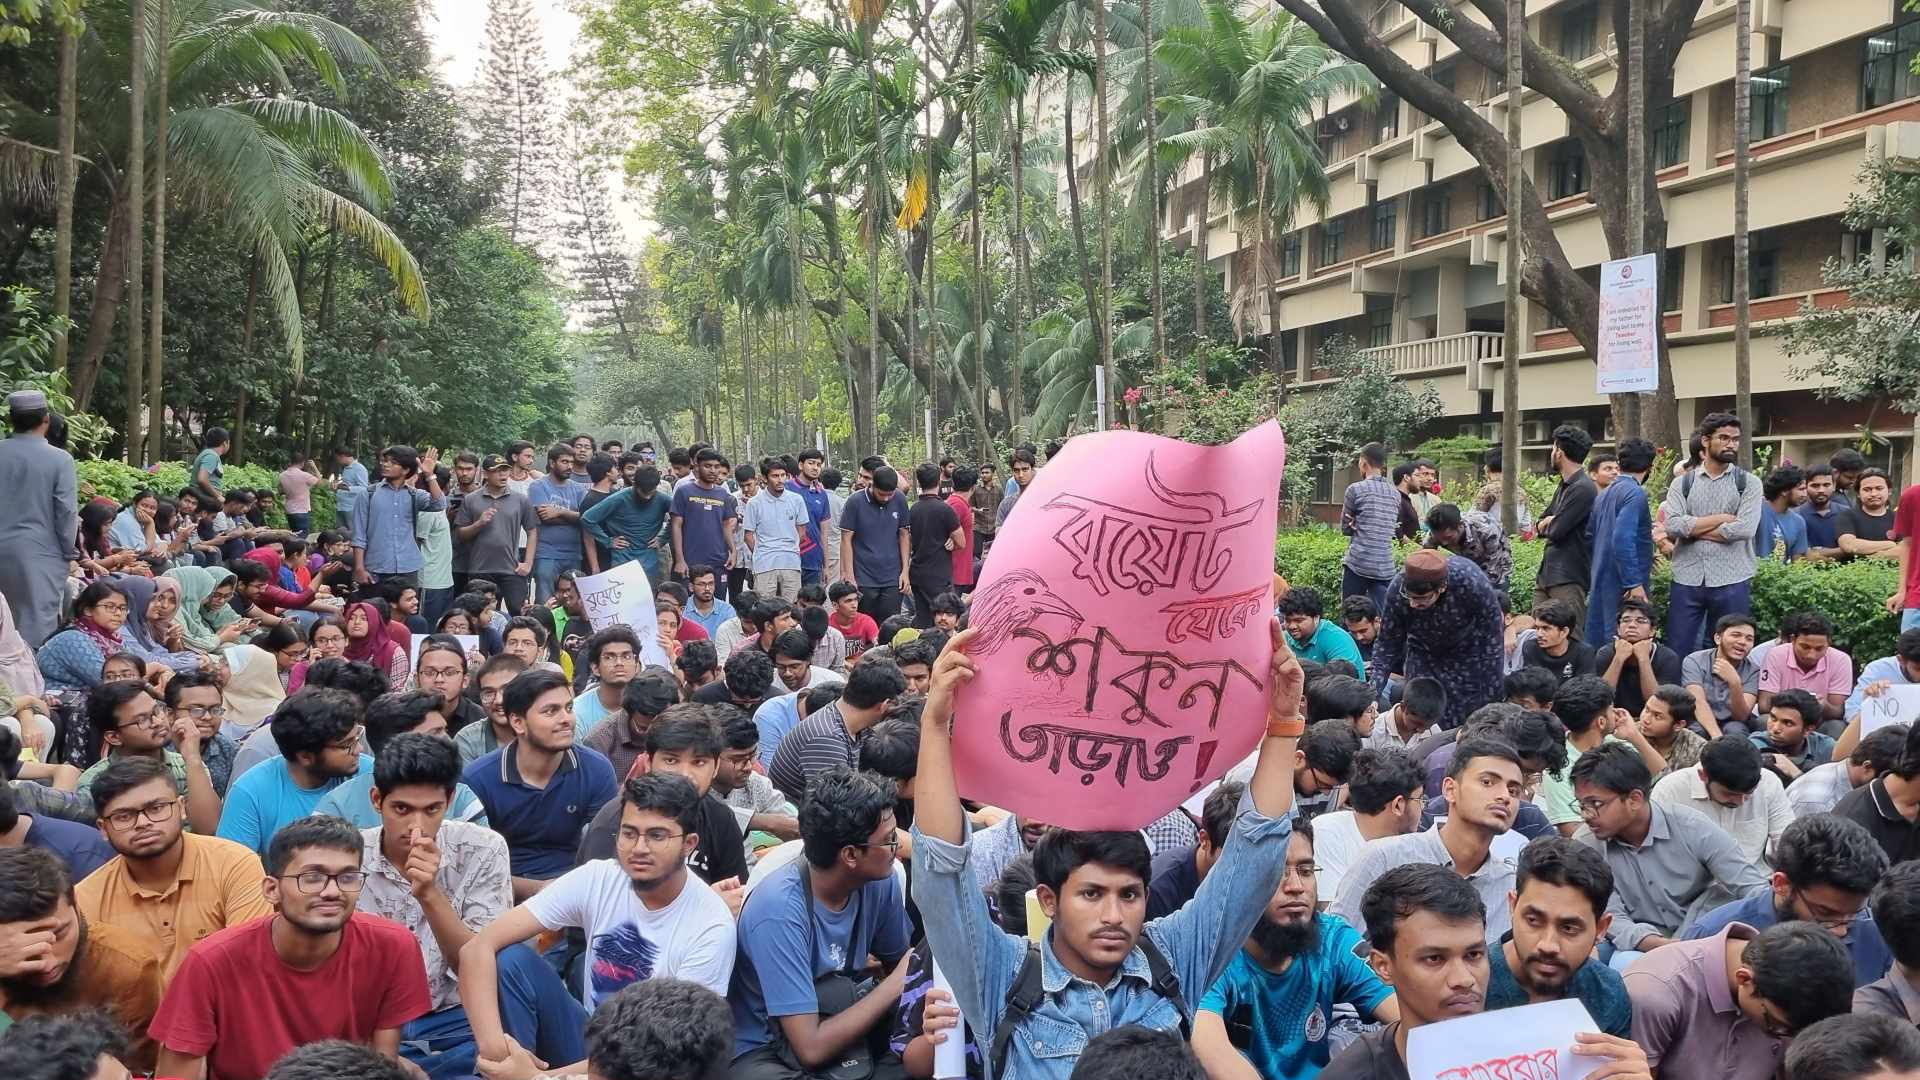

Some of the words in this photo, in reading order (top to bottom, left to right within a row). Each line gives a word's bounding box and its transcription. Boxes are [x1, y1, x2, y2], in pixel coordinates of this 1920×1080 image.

[1040, 449, 1264, 597] বুয়েট
[1159, 584, 1271, 645] থেকে
[1011, 625, 1265, 731] শকুন
[1872, 697, 1900, 718] NO
